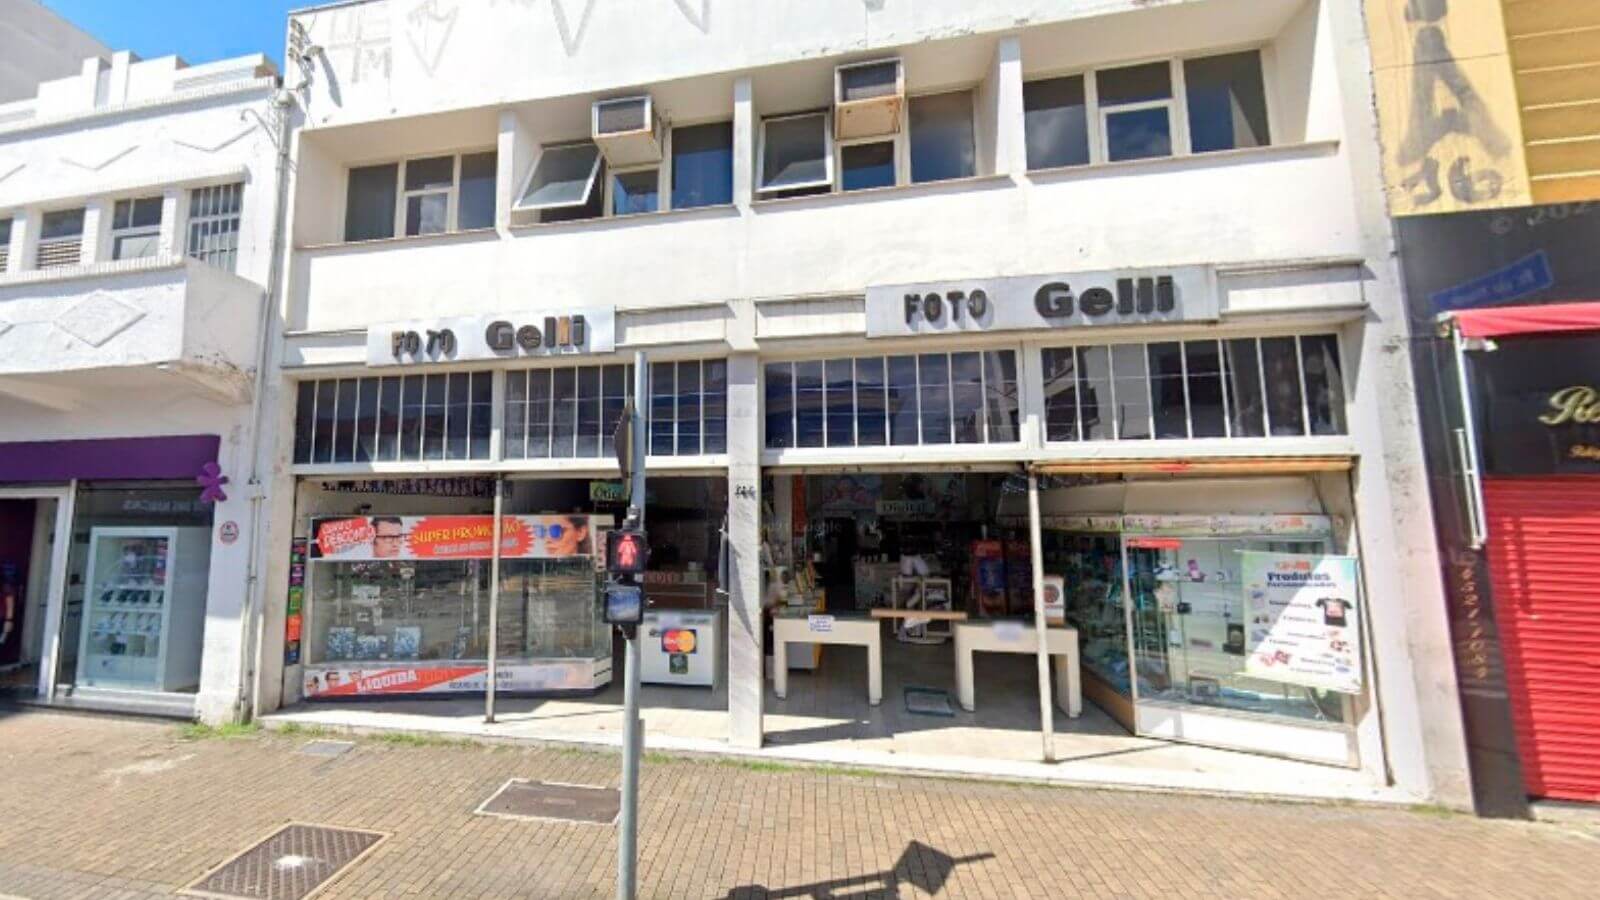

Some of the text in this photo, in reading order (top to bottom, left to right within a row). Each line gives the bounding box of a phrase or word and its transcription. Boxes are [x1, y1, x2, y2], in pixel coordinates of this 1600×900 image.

[904, 275, 1175, 325] FOTO Gelli
[485, 314, 585, 351] Gelli
[413, 527, 451, 546] SUPER
[1266, 571, 1332, 582] Produtos
